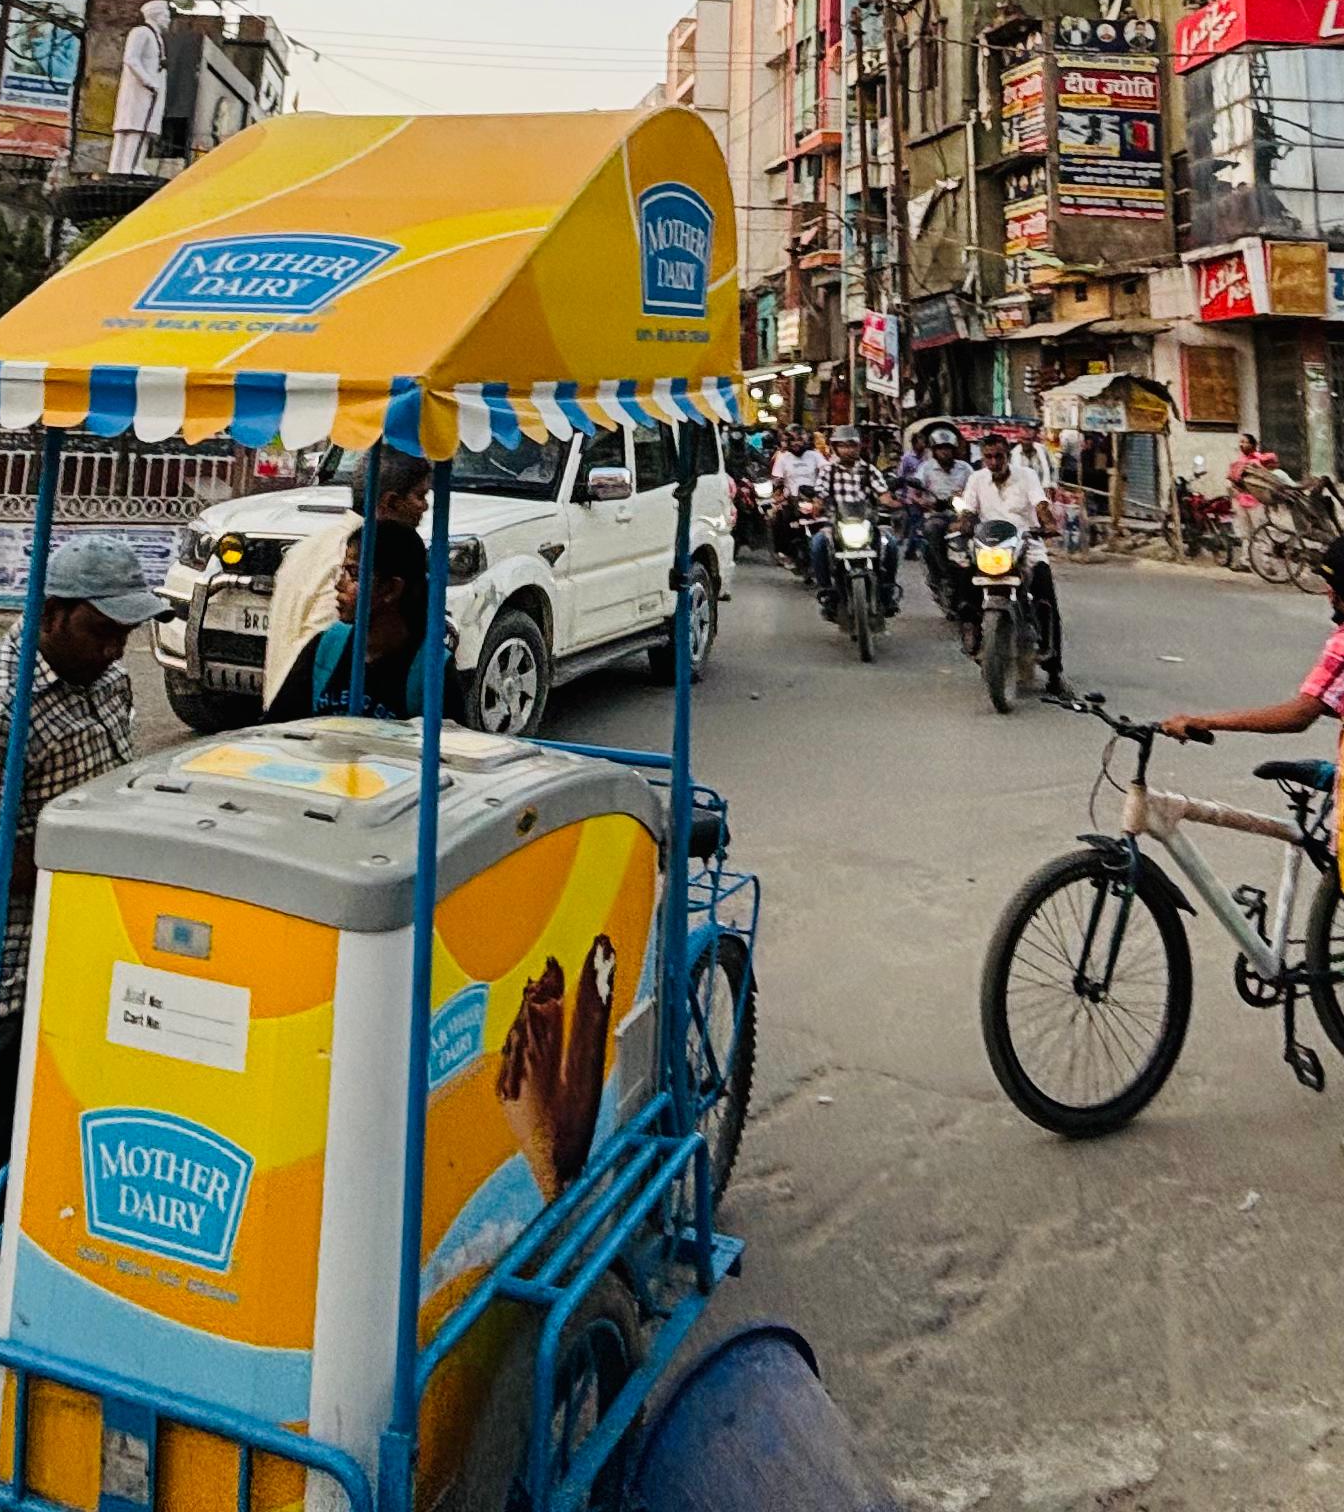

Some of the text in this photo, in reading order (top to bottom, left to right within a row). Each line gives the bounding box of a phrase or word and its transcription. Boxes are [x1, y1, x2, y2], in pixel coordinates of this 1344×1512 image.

[1062, 71, 1156, 98] दीप ज्योति
[646, 215, 706, 259] MOTHER
[185, 251, 360, 281] MOTHER
[656, 257, 698, 291] DAIRY
[189, 276, 314, 298] DAIRY
[243, 608, 259, 631] BR
[99, 1139, 231, 1214] MOTHER
[117, 1185, 206, 1236] DAIRY
